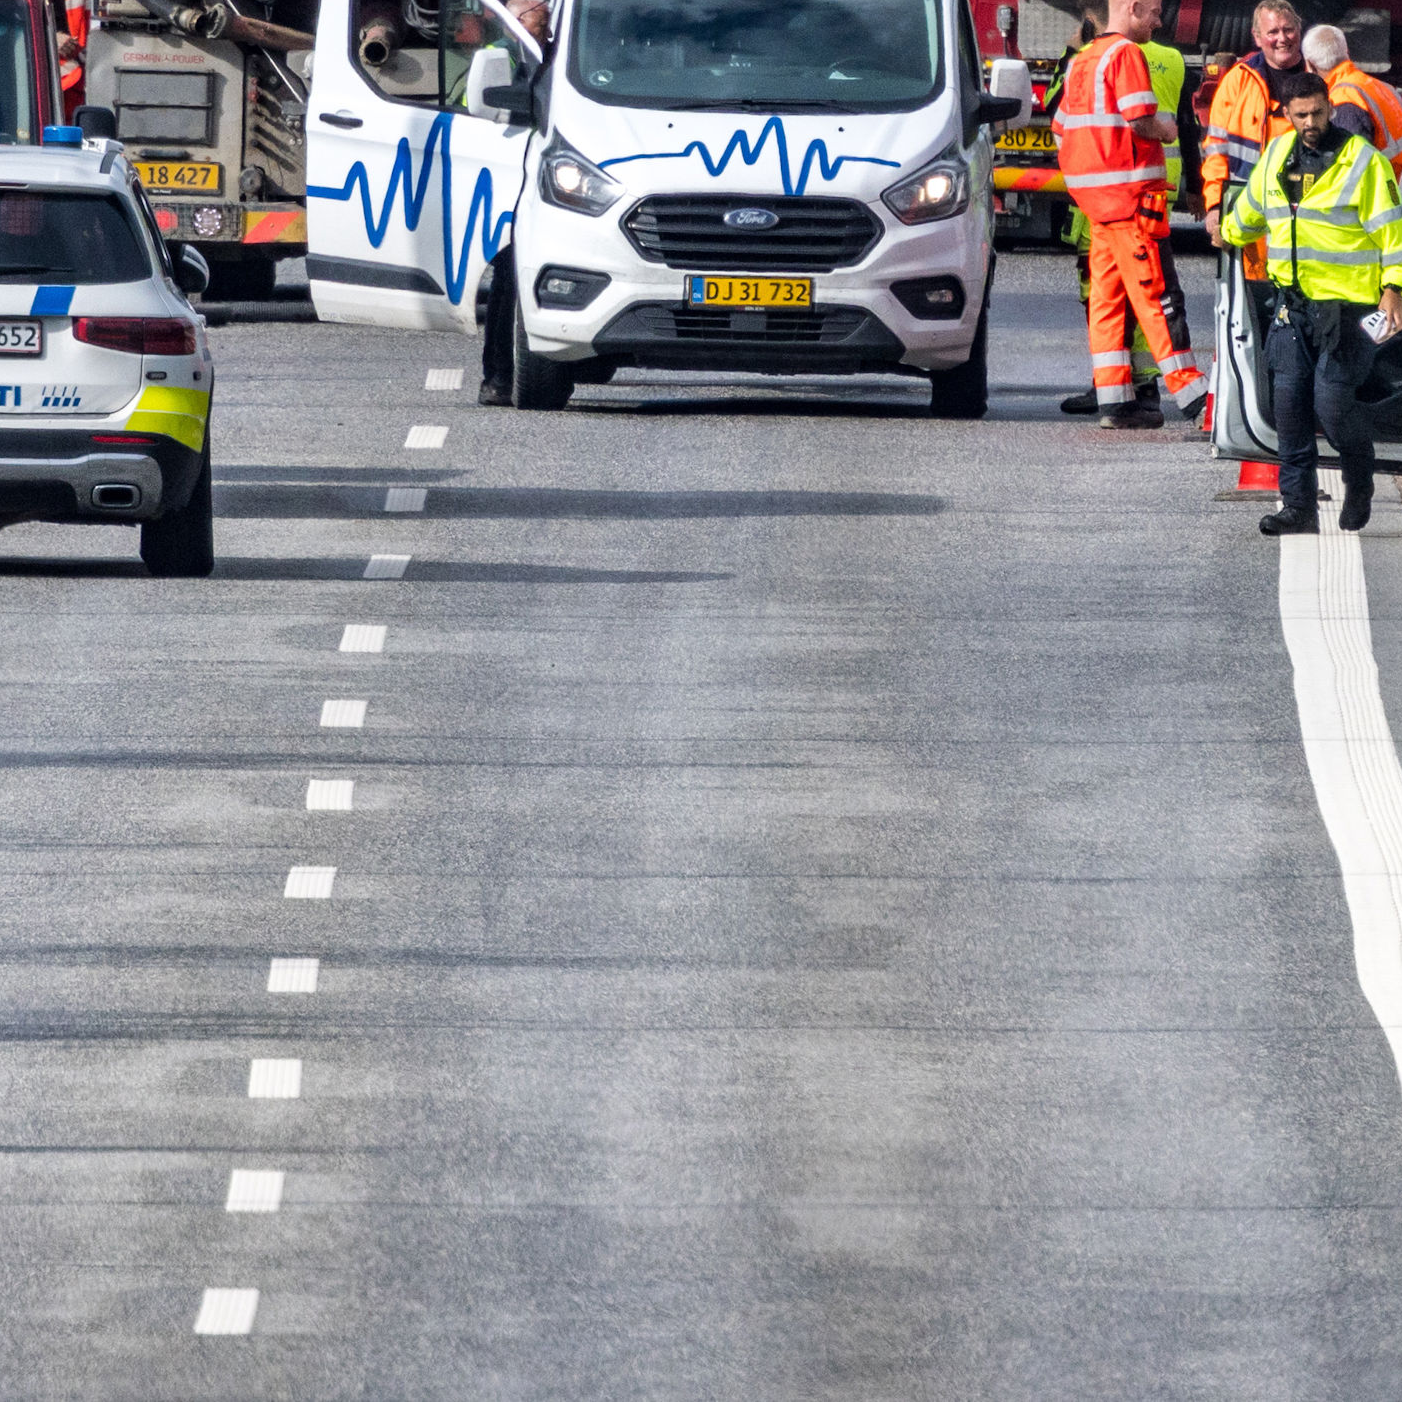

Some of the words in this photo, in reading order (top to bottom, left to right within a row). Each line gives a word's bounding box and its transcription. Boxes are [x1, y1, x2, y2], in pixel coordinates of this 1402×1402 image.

[1004, 128, 1027, 147] 80
[1031, 128, 1054, 147] 20
[148, 166, 169, 185] 18
[174, 166, 212, 186] 427
[737, 211, 768, 225] Ford
[706, 281, 733, 301] DJ
[739, 282, 761, 301] 31
[769, 282, 807, 302] 732
